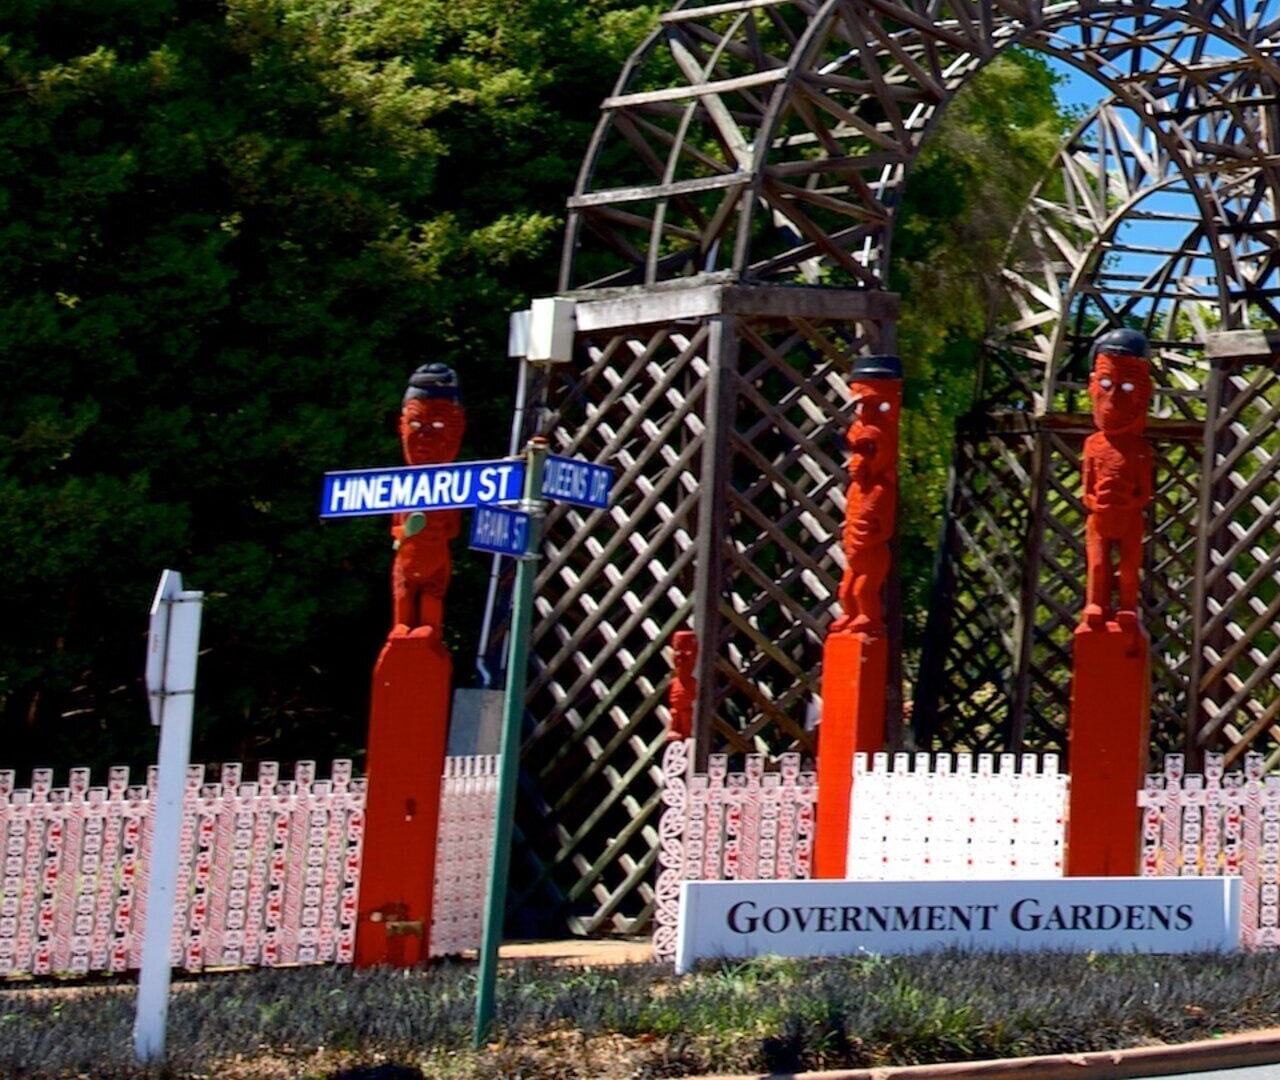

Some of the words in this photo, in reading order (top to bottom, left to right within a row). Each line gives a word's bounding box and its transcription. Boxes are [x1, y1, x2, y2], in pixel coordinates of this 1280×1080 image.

[330, 469, 472, 512] HINEMARU
[477, 466, 513, 501] ST
[541, 459, 588, 500] QUEENS
[589, 469, 608, 503] DR
[512, 516, 527, 551] ST
[726, 900, 999, 934] GOVERNMENT
[1010, 898, 1194, 931] GARDENS
